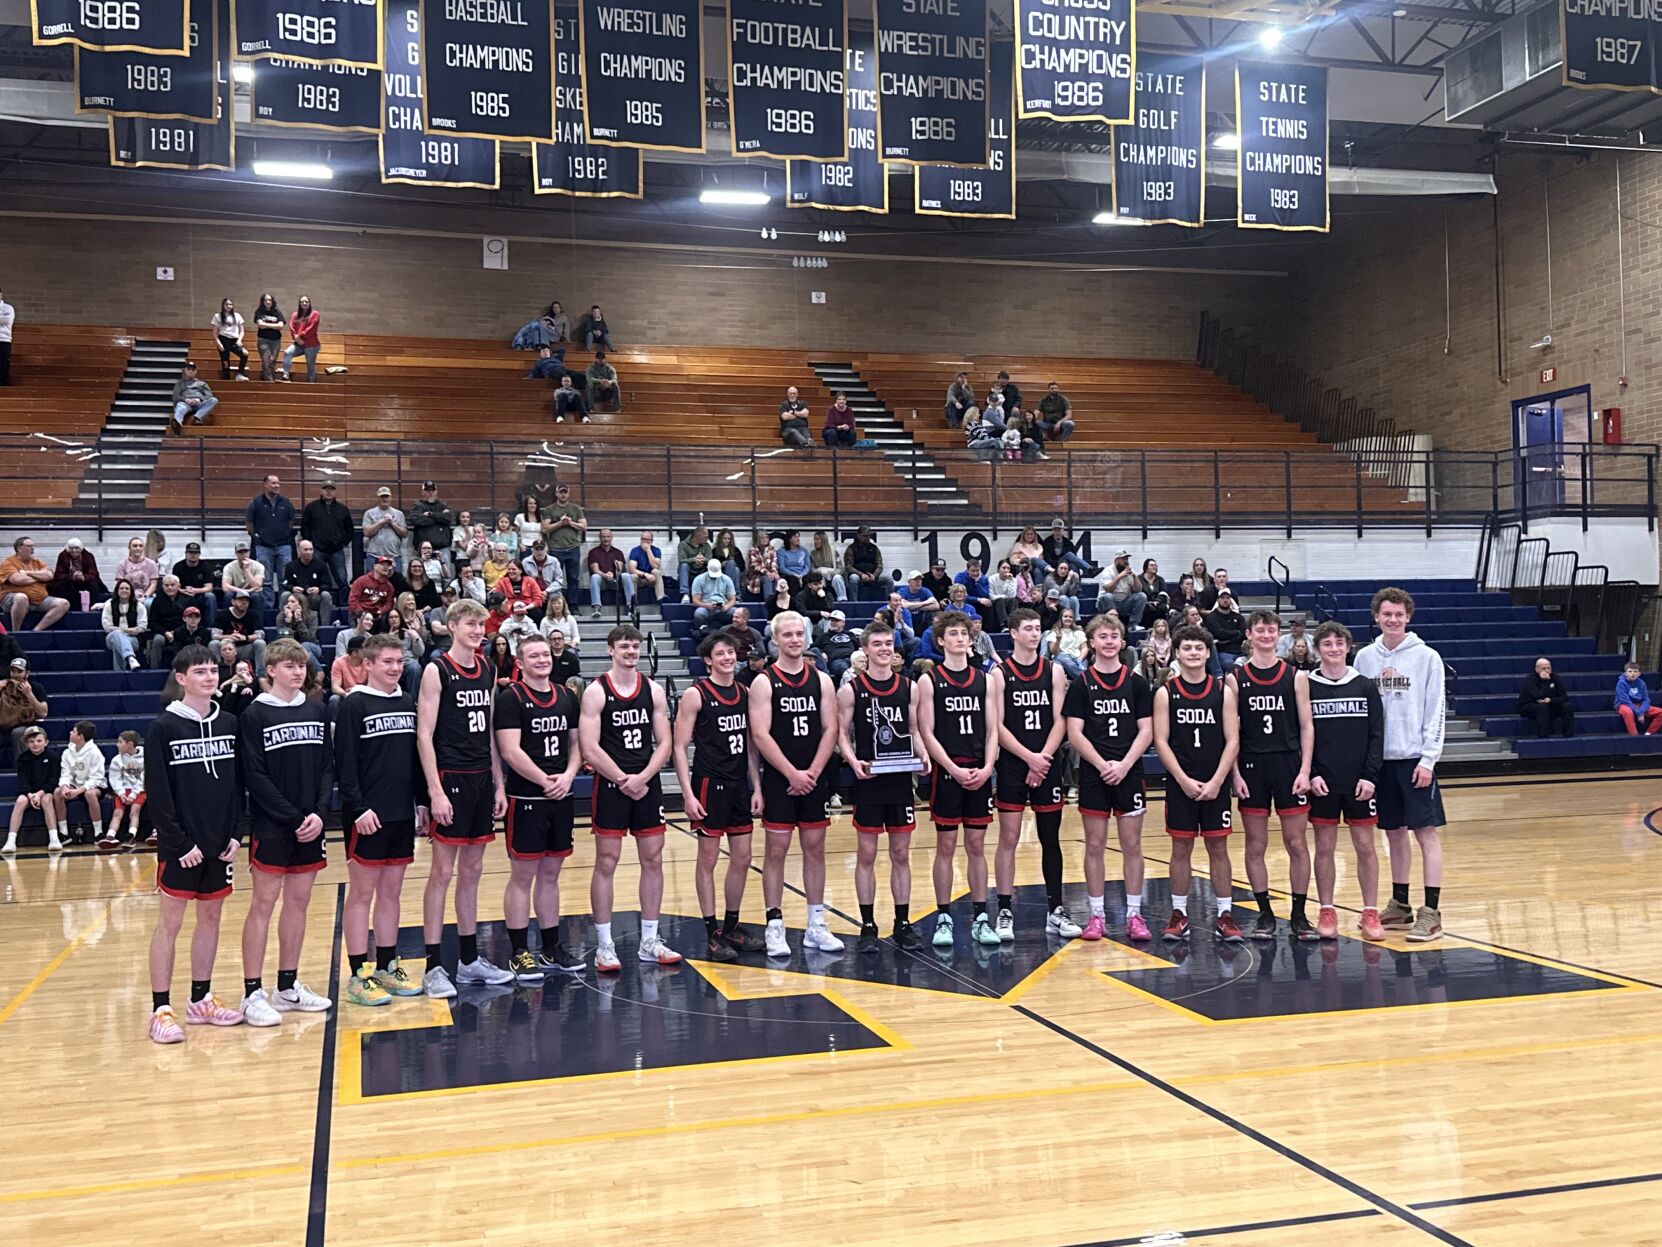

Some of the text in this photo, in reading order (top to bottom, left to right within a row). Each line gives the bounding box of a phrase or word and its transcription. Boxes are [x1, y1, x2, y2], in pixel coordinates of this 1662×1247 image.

[78, 0, 140, 30] 1986
[446, 0, 528, 25] BASEBALL
[597, 6, 686, 38] WRESTLING
[43, 23, 74, 35] GORRELL
[276, 13, 336, 44] 1986
[733, 19, 842, 51] FOOTBALL
[1029, 12, 1126, 45] COUNTRY
[242, 40, 271, 51] GORRELL
[879, 30, 984, 59] WRESTLING
[1595, 37, 1641, 64] 1987
[446, 43, 532, 72] CHAMPIONS
[601, 53, 684, 82] CHAMPIONS
[1021, 44, 1130, 78] CHAMPIONS
[127, 64, 171, 91] 1983
[734, 63, 843, 94] CHAMPIONS
[881, 72, 984, 101] CHAMPIONS
[1136, 72, 1184, 95] STATE
[298, 84, 339, 112] 1983
[1055, 81, 1103, 106] 1986
[1260, 82, 1307, 104] STATE
[259, 107, 272, 115] ROY
[471, 91, 509, 116] 1985
[626, 100, 662, 126] 1985
[432, 118, 456, 128] BROOKS
[767, 108, 814, 134] 1986
[911, 117, 955, 141] 1986
[1140, 109, 1178, 130] GOLF
[1260, 117, 1307, 139] TENNIS
[151, 128, 193, 152] 1981
[594, 128, 618, 138] BURNETT
[421, 141, 458, 165] 1981
[1120, 143, 1196, 168] CHAMPIONS
[568, 156, 607, 179] 1982
[1246, 152, 1322, 176] CHAMPIONS
[821, 164, 853, 186] 1982
[950, 180, 982, 201] 1983
[1143, 181, 1174, 201] 1983
[1270, 188, 1298, 209] 1983
[456, 690, 490, 707] SODA
[781, 696, 816, 712] SODA
[945, 697, 980, 711] SODA
[1013, 690, 1049, 706] SODA
[1094, 699, 1130, 714] SODA
[1249, 696, 1285, 710] SODA
[1313, 702, 1368, 714] ARDINALS
[468, 711, 486, 732] 20
[612, 708, 649, 726] SODA
[718, 714, 746, 732] SODA
[866, 706, 904, 722] SDA
[1025, 710, 1041, 729] 21
[1177, 709, 1216, 723] SODA
[365, 716, 415, 733] CARDINA
[532, 716, 568, 733] SODA
[793, 716, 809, 736] 15
[959, 715, 973, 734] 11
[1108, 718, 1118, 736] 2
[1263, 715, 1272, 734] 3
[264, 728, 324, 746] CARDINALS
[544, 736, 559, 756] 12
[623, 729, 642, 749] 22
[729, 734, 743, 754] 23
[1194, 728, 1201, 747] 1
[172, 740, 234, 759] CARDINAL
[1053, 787, 1061, 803] S
[1134, 793, 1142, 809] S
[659, 806, 666, 823] S
[906, 807, 913, 823] S
[1369, 799, 1376, 816] S
[1222, 811, 1231, 828] S
